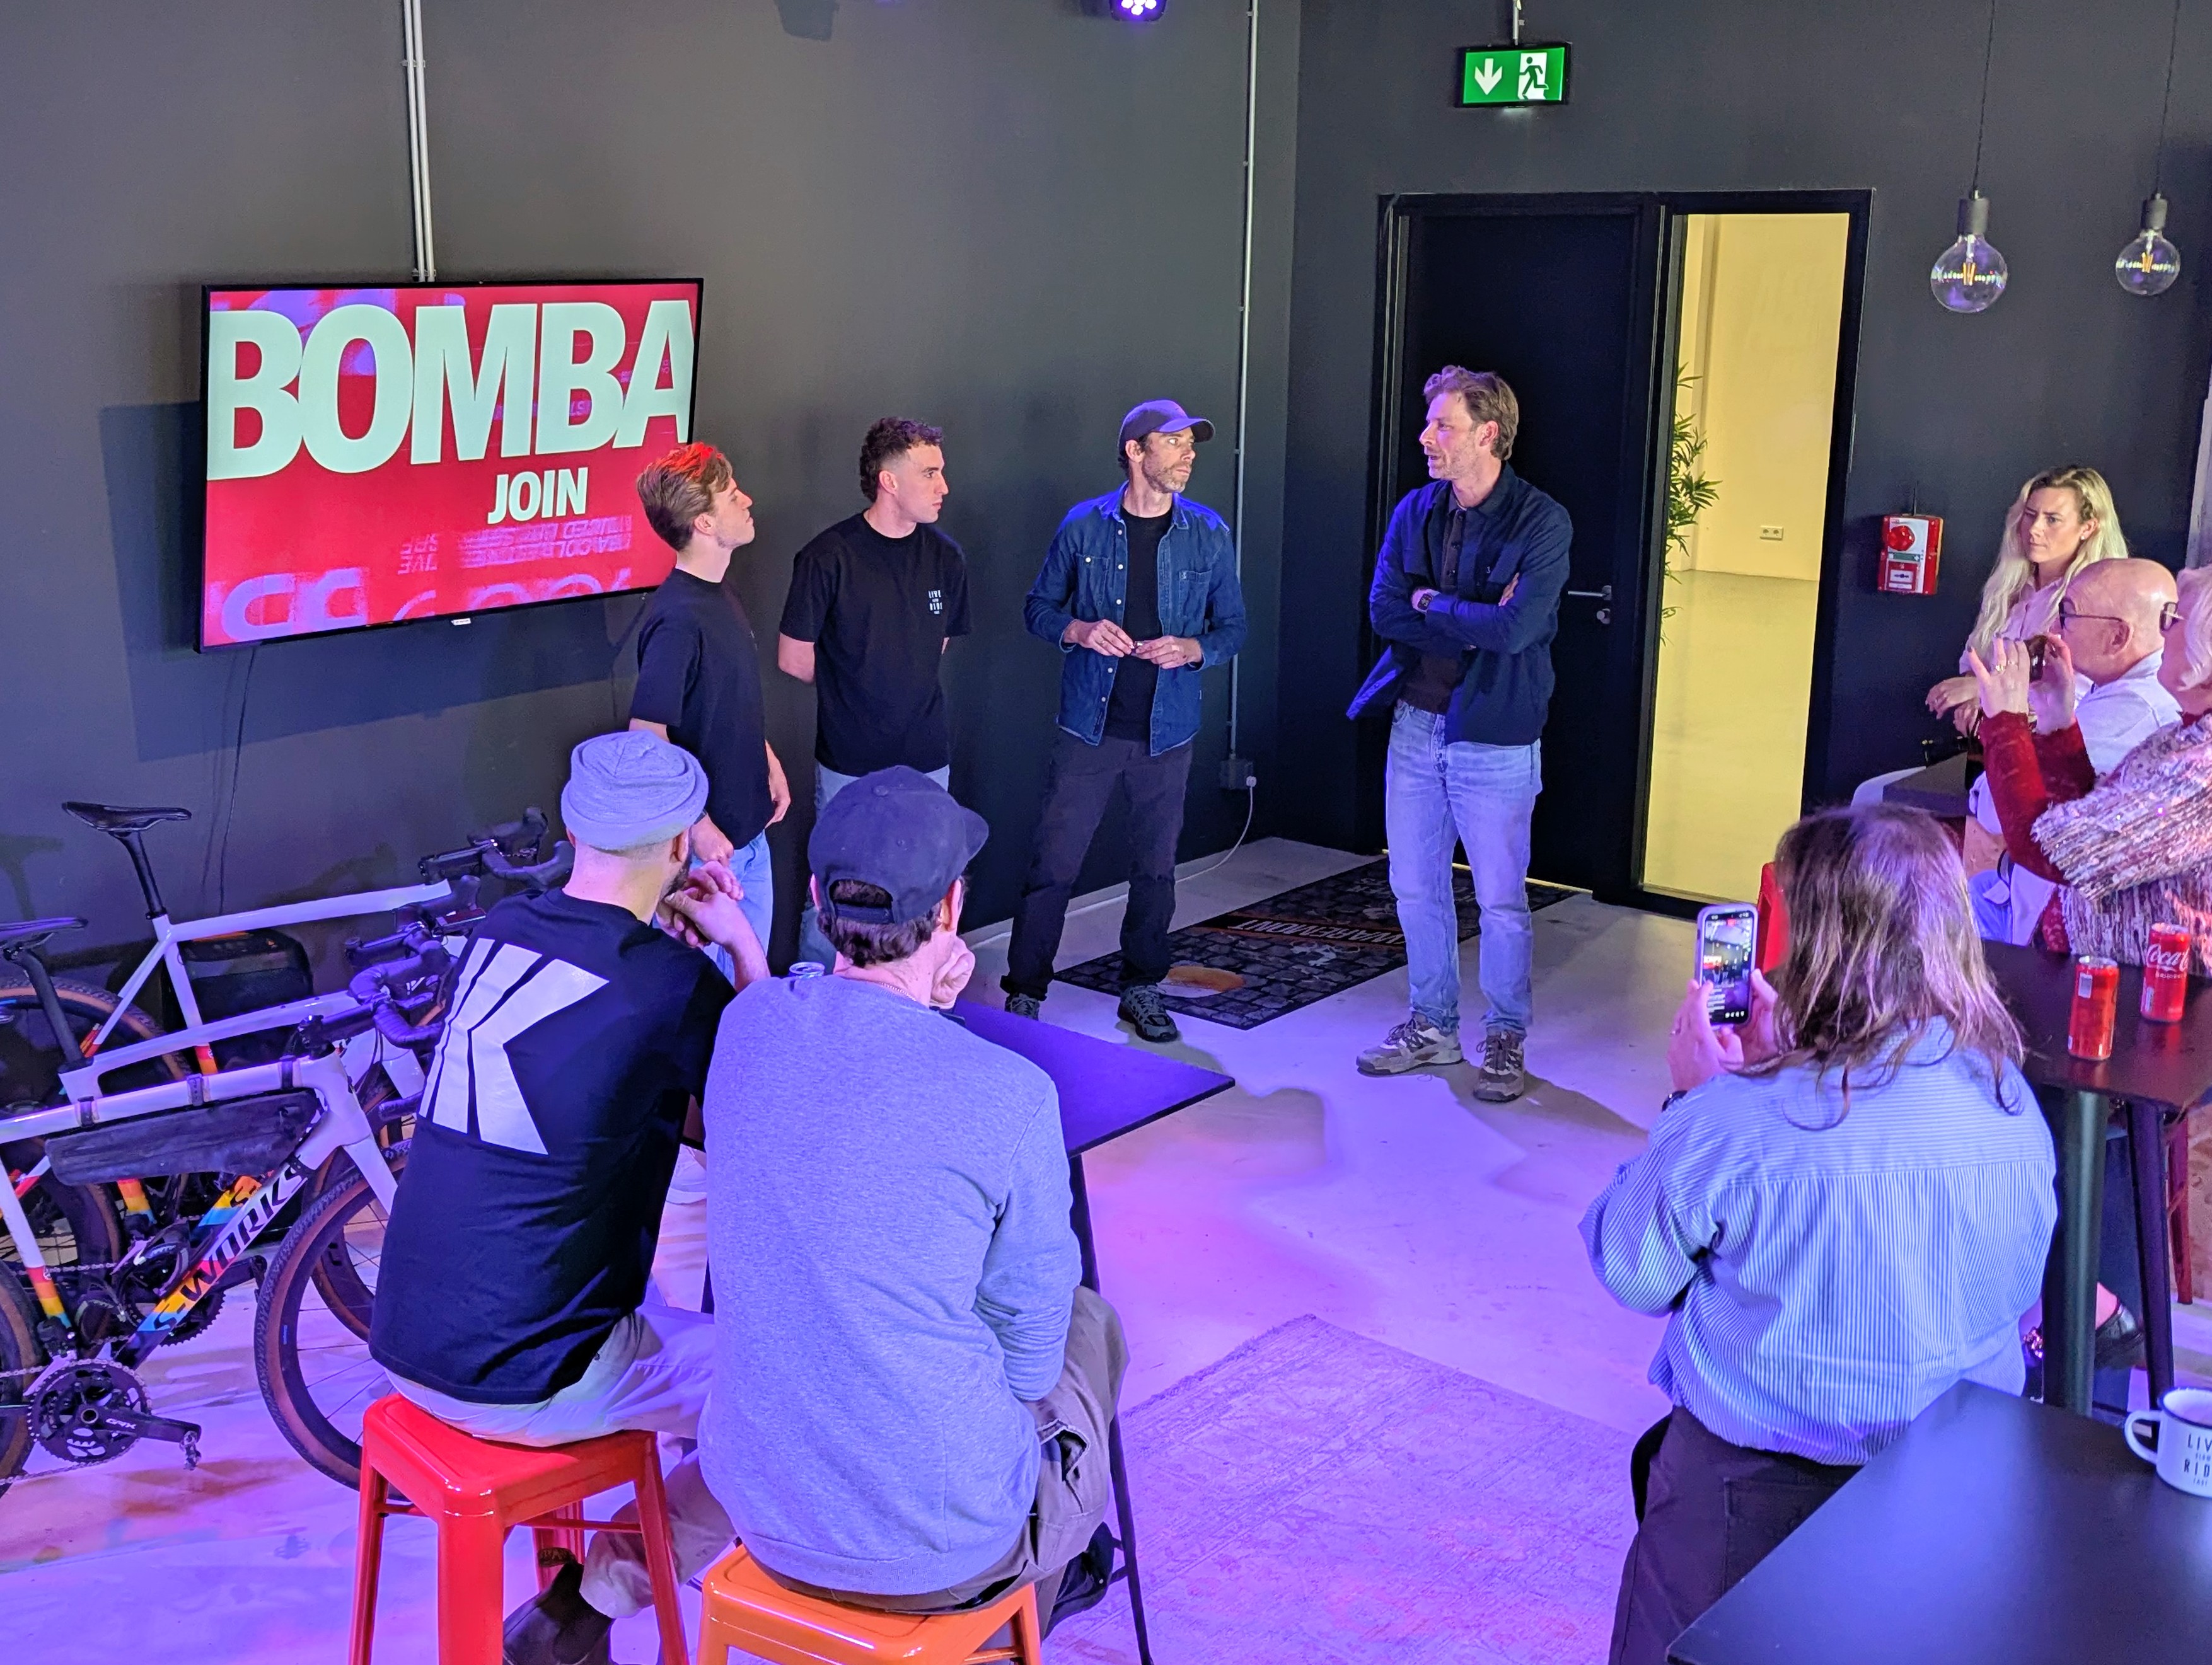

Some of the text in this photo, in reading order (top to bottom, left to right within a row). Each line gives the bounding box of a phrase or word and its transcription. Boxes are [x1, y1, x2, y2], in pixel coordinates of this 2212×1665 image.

[207, 300, 694, 481] BOMBA
[487, 467, 588, 524] JOIN
[1227, 919, 1406, 944] WAREMONT
[154, 1157, 304, 1330] S-WORKS
